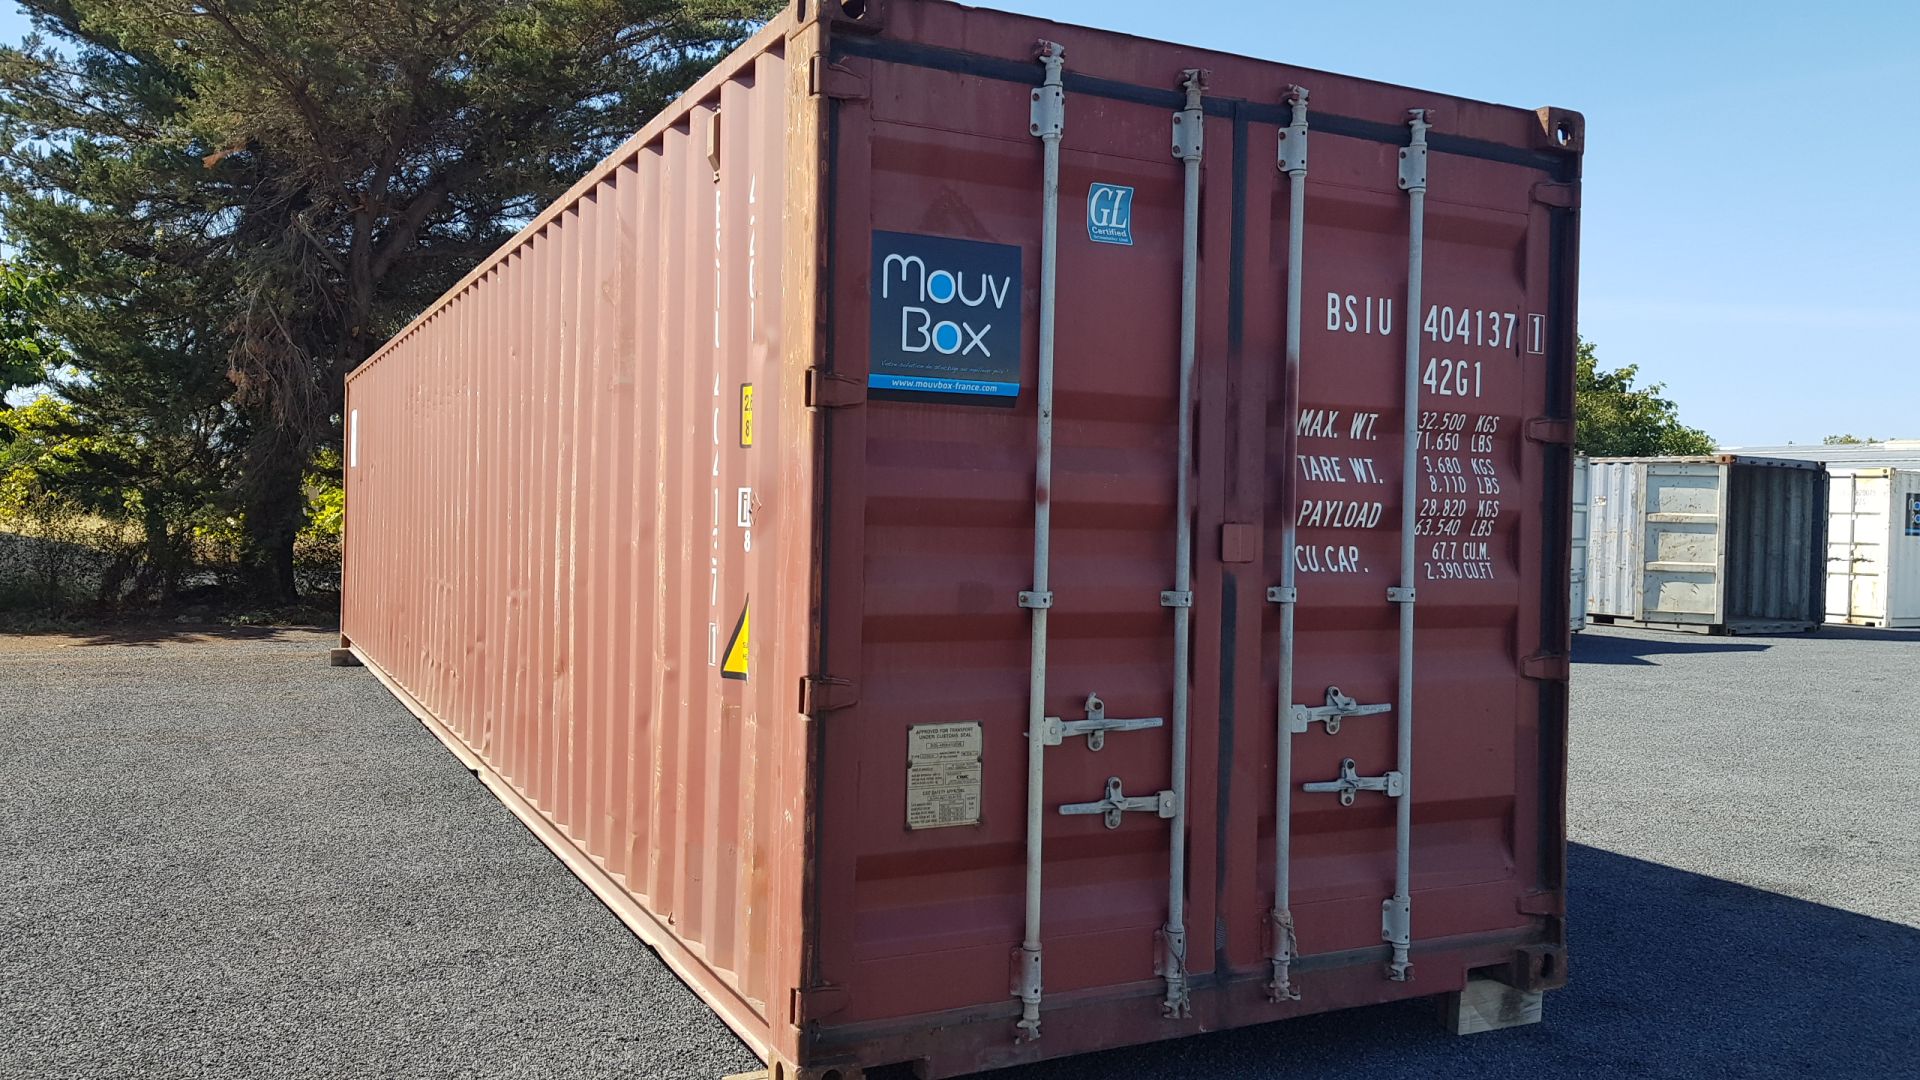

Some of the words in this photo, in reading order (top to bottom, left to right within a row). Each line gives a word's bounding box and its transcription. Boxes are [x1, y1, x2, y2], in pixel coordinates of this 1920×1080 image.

[1090, 187, 1127, 228] GL
[1091, 226, 1127, 237] Certified
[1326, 292, 1392, 335] BSIU
[1423, 305, 1516, 349] 404137
[892, 379, 998, 393] www.mouvbox-france.com
[1423, 357, 1482, 398] 42G1
[1297, 409, 1339, 439] MAX.
[1350, 412, 1379, 441] WT.
[1475, 415, 1500, 433] KGS
[1471, 434, 1493, 453] LBS
[1297, 455, 1346, 482] TARE
[1349, 457, 1384, 484] WT.
[1471, 457, 1495, 475] KGS
[1476, 476, 1500, 495] LBS
[1296, 499, 1383, 529] PAYLOAD
[1476, 499, 1500, 518] KGS
[1470, 519, 1495, 537] LBS
[1432, 541, 1457, 560] 67.7
